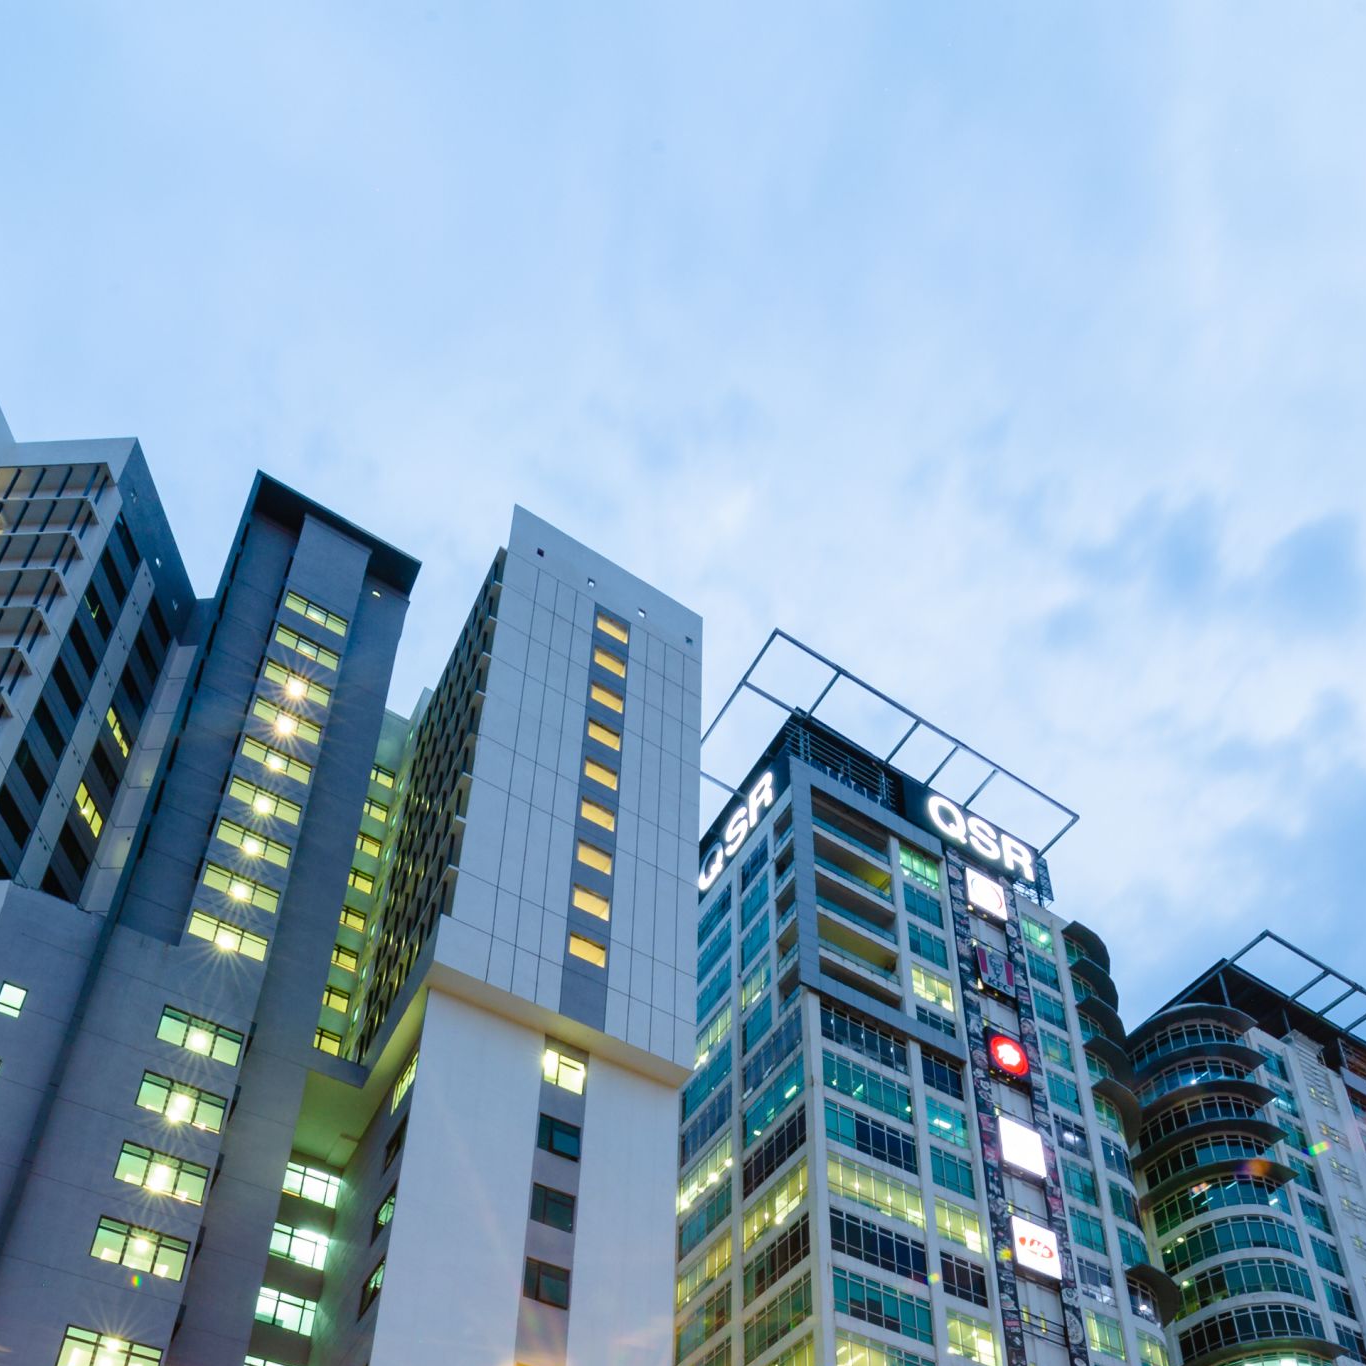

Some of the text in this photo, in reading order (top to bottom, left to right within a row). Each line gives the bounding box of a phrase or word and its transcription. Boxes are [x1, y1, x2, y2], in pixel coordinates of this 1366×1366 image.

[698, 772, 773, 891] QSR
[928, 796, 1034, 881] QSR
[987, 976, 1011, 993] KFC
